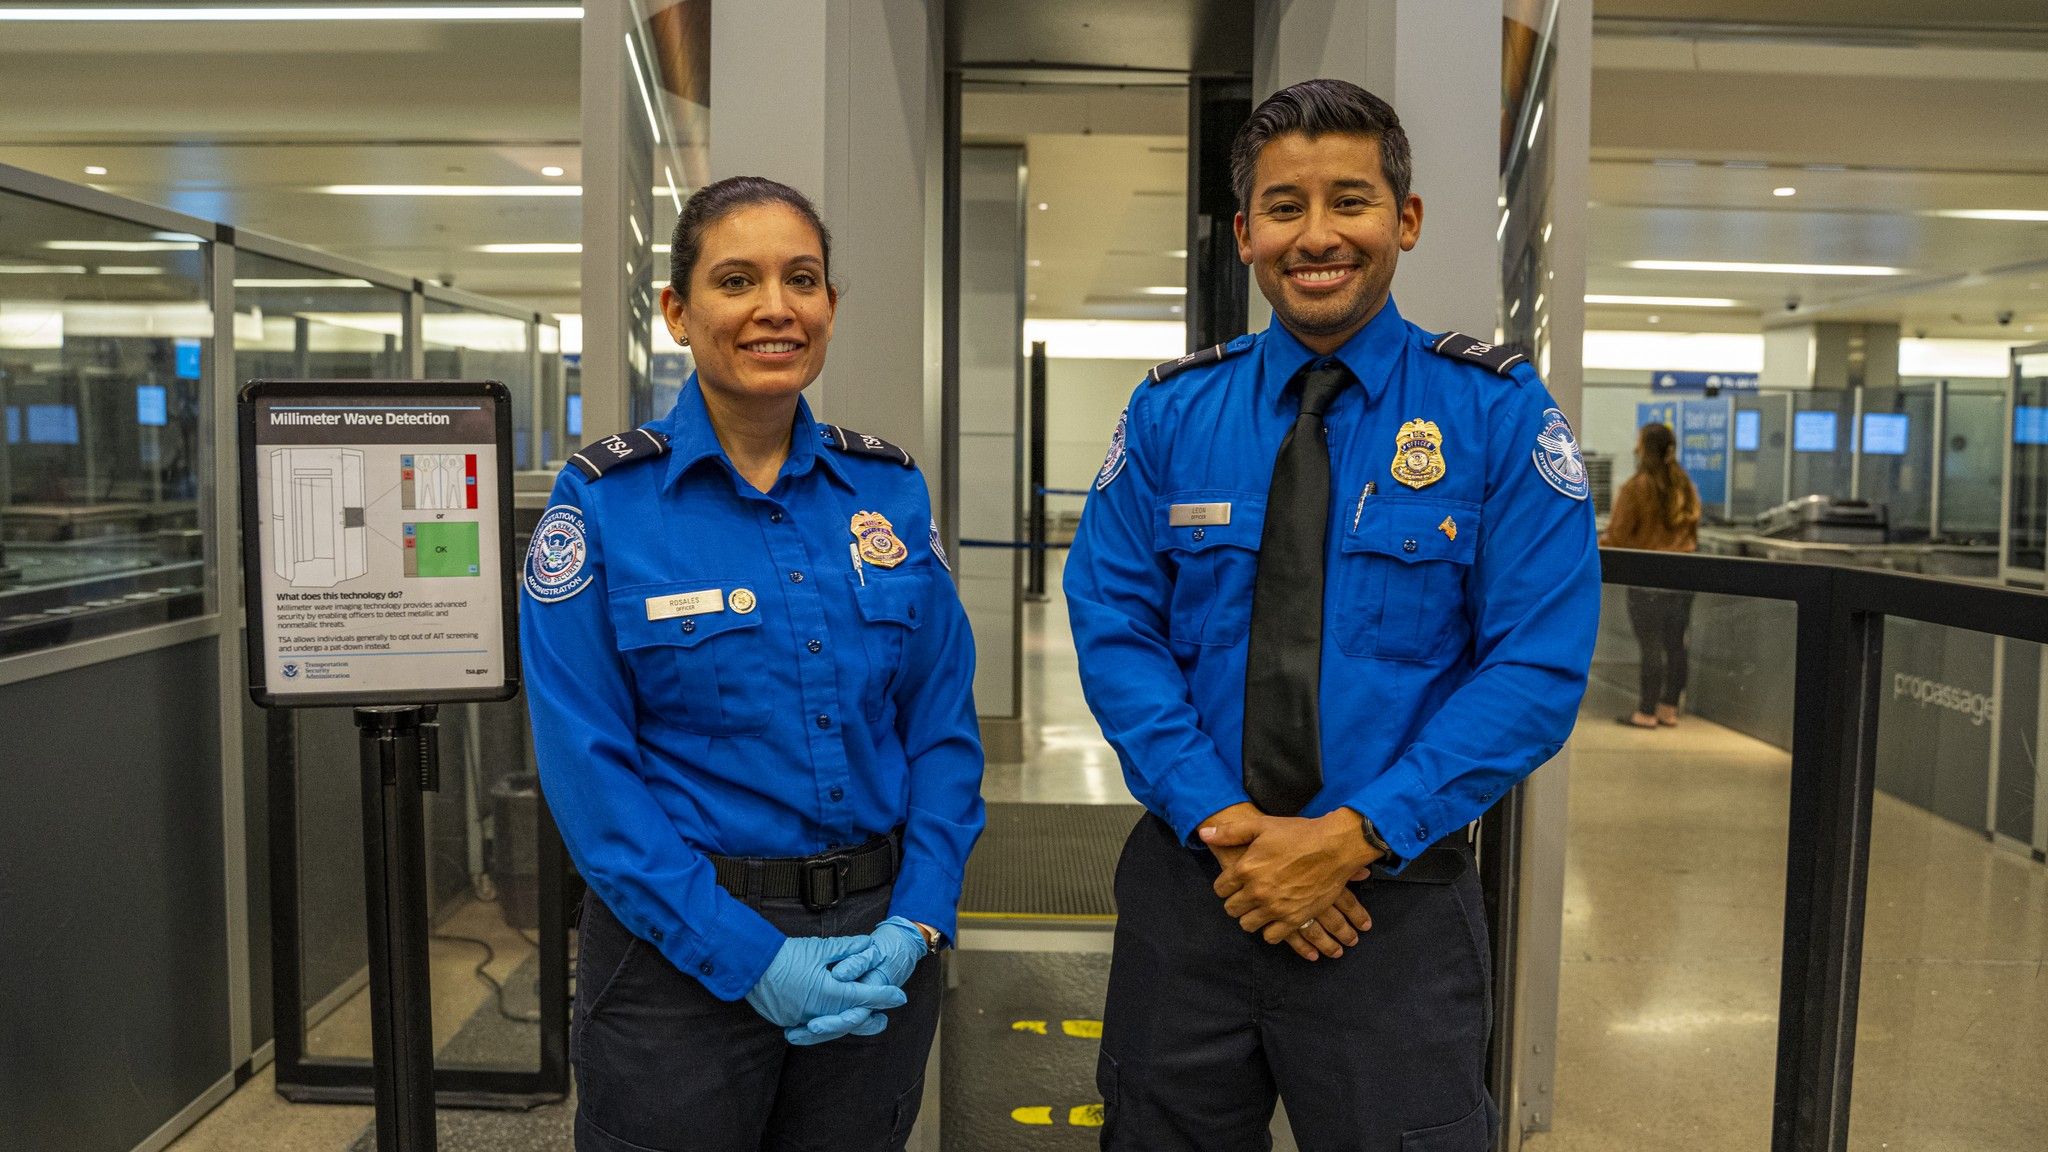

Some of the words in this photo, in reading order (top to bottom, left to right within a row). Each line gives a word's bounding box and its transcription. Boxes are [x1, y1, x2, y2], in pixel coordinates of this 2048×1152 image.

[1462, 342, 1495, 356] TSA
[270, 412, 341, 425] Millimeter
[344, 412, 382, 425] Wave
[386, 412, 450, 425] Detection
[600, 434, 634, 458] TSA
[435, 546, 448, 554] OK
[528, 575, 582, 596] ADMINISTRATION
[340, 591, 386, 601] technology
[669, 596, 700, 606] ROSALES
[356, 634, 388, 642] generally
